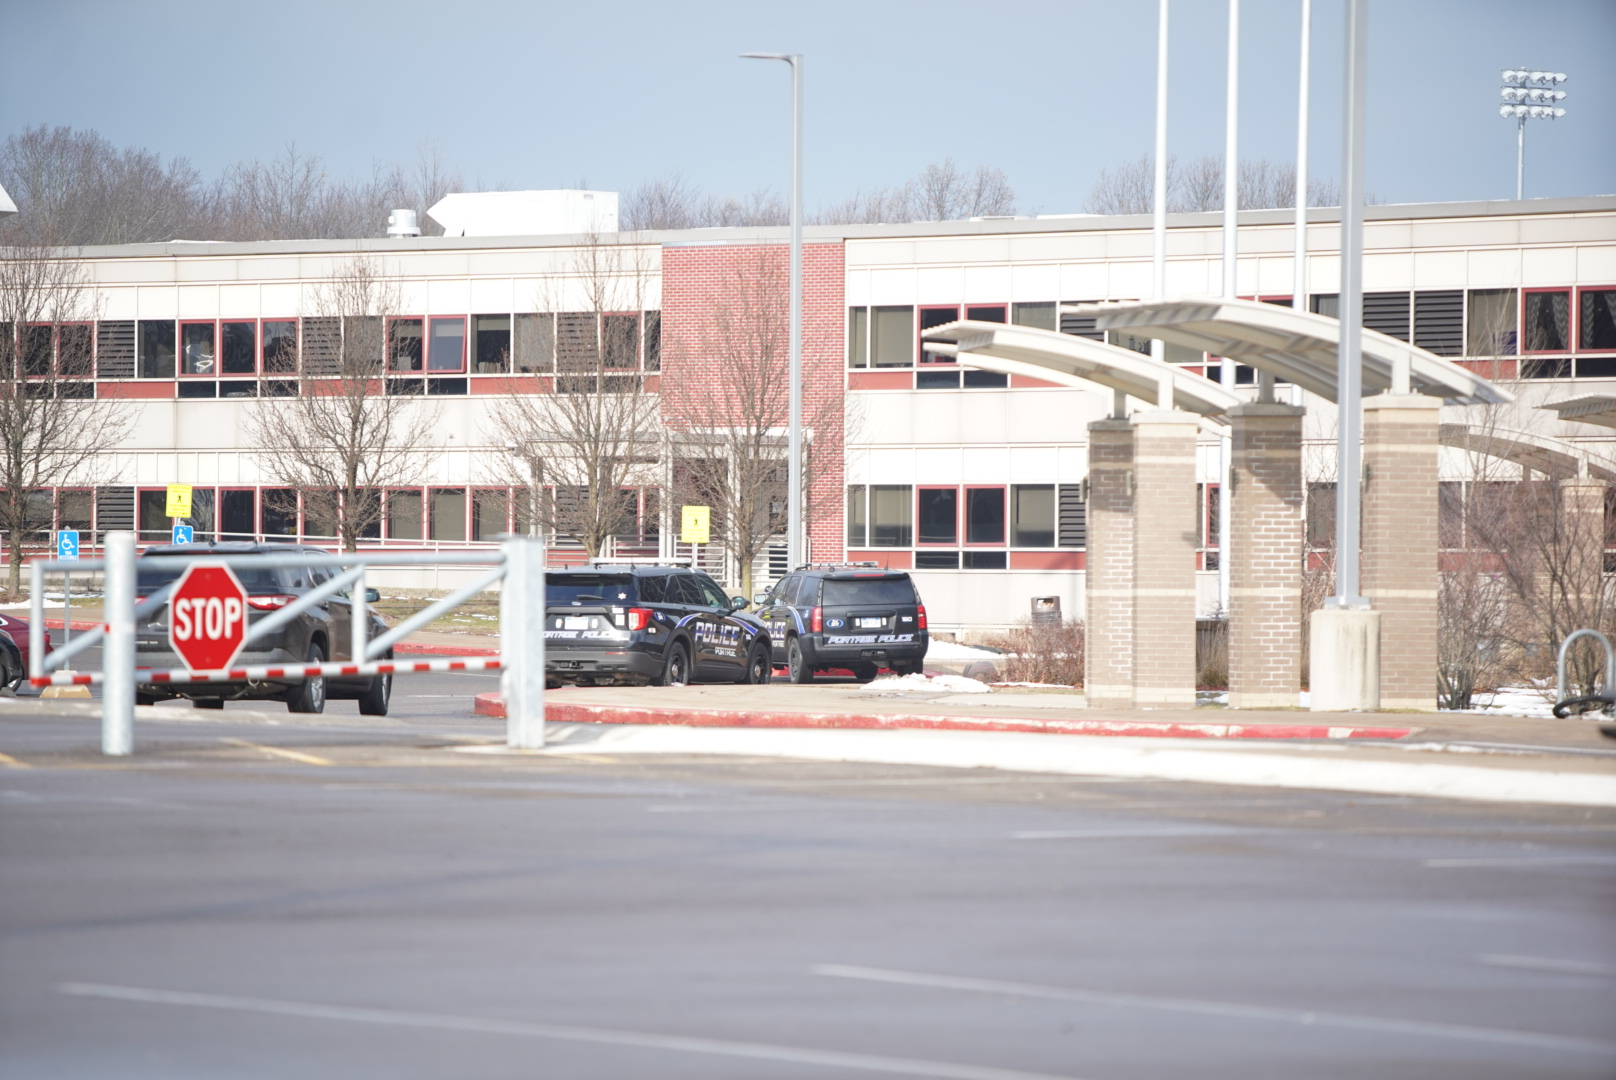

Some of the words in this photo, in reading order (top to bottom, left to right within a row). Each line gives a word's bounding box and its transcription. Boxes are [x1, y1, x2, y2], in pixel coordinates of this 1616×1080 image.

[175, 597, 242, 641] STOP
[542, 630, 578, 639] ORTAGE
[695, 622, 739, 646] POLICE
[828, 635, 877, 644] PORTAGE
[878, 634, 914, 642] POLICE
[714, 646, 737, 657] PORTAGE
